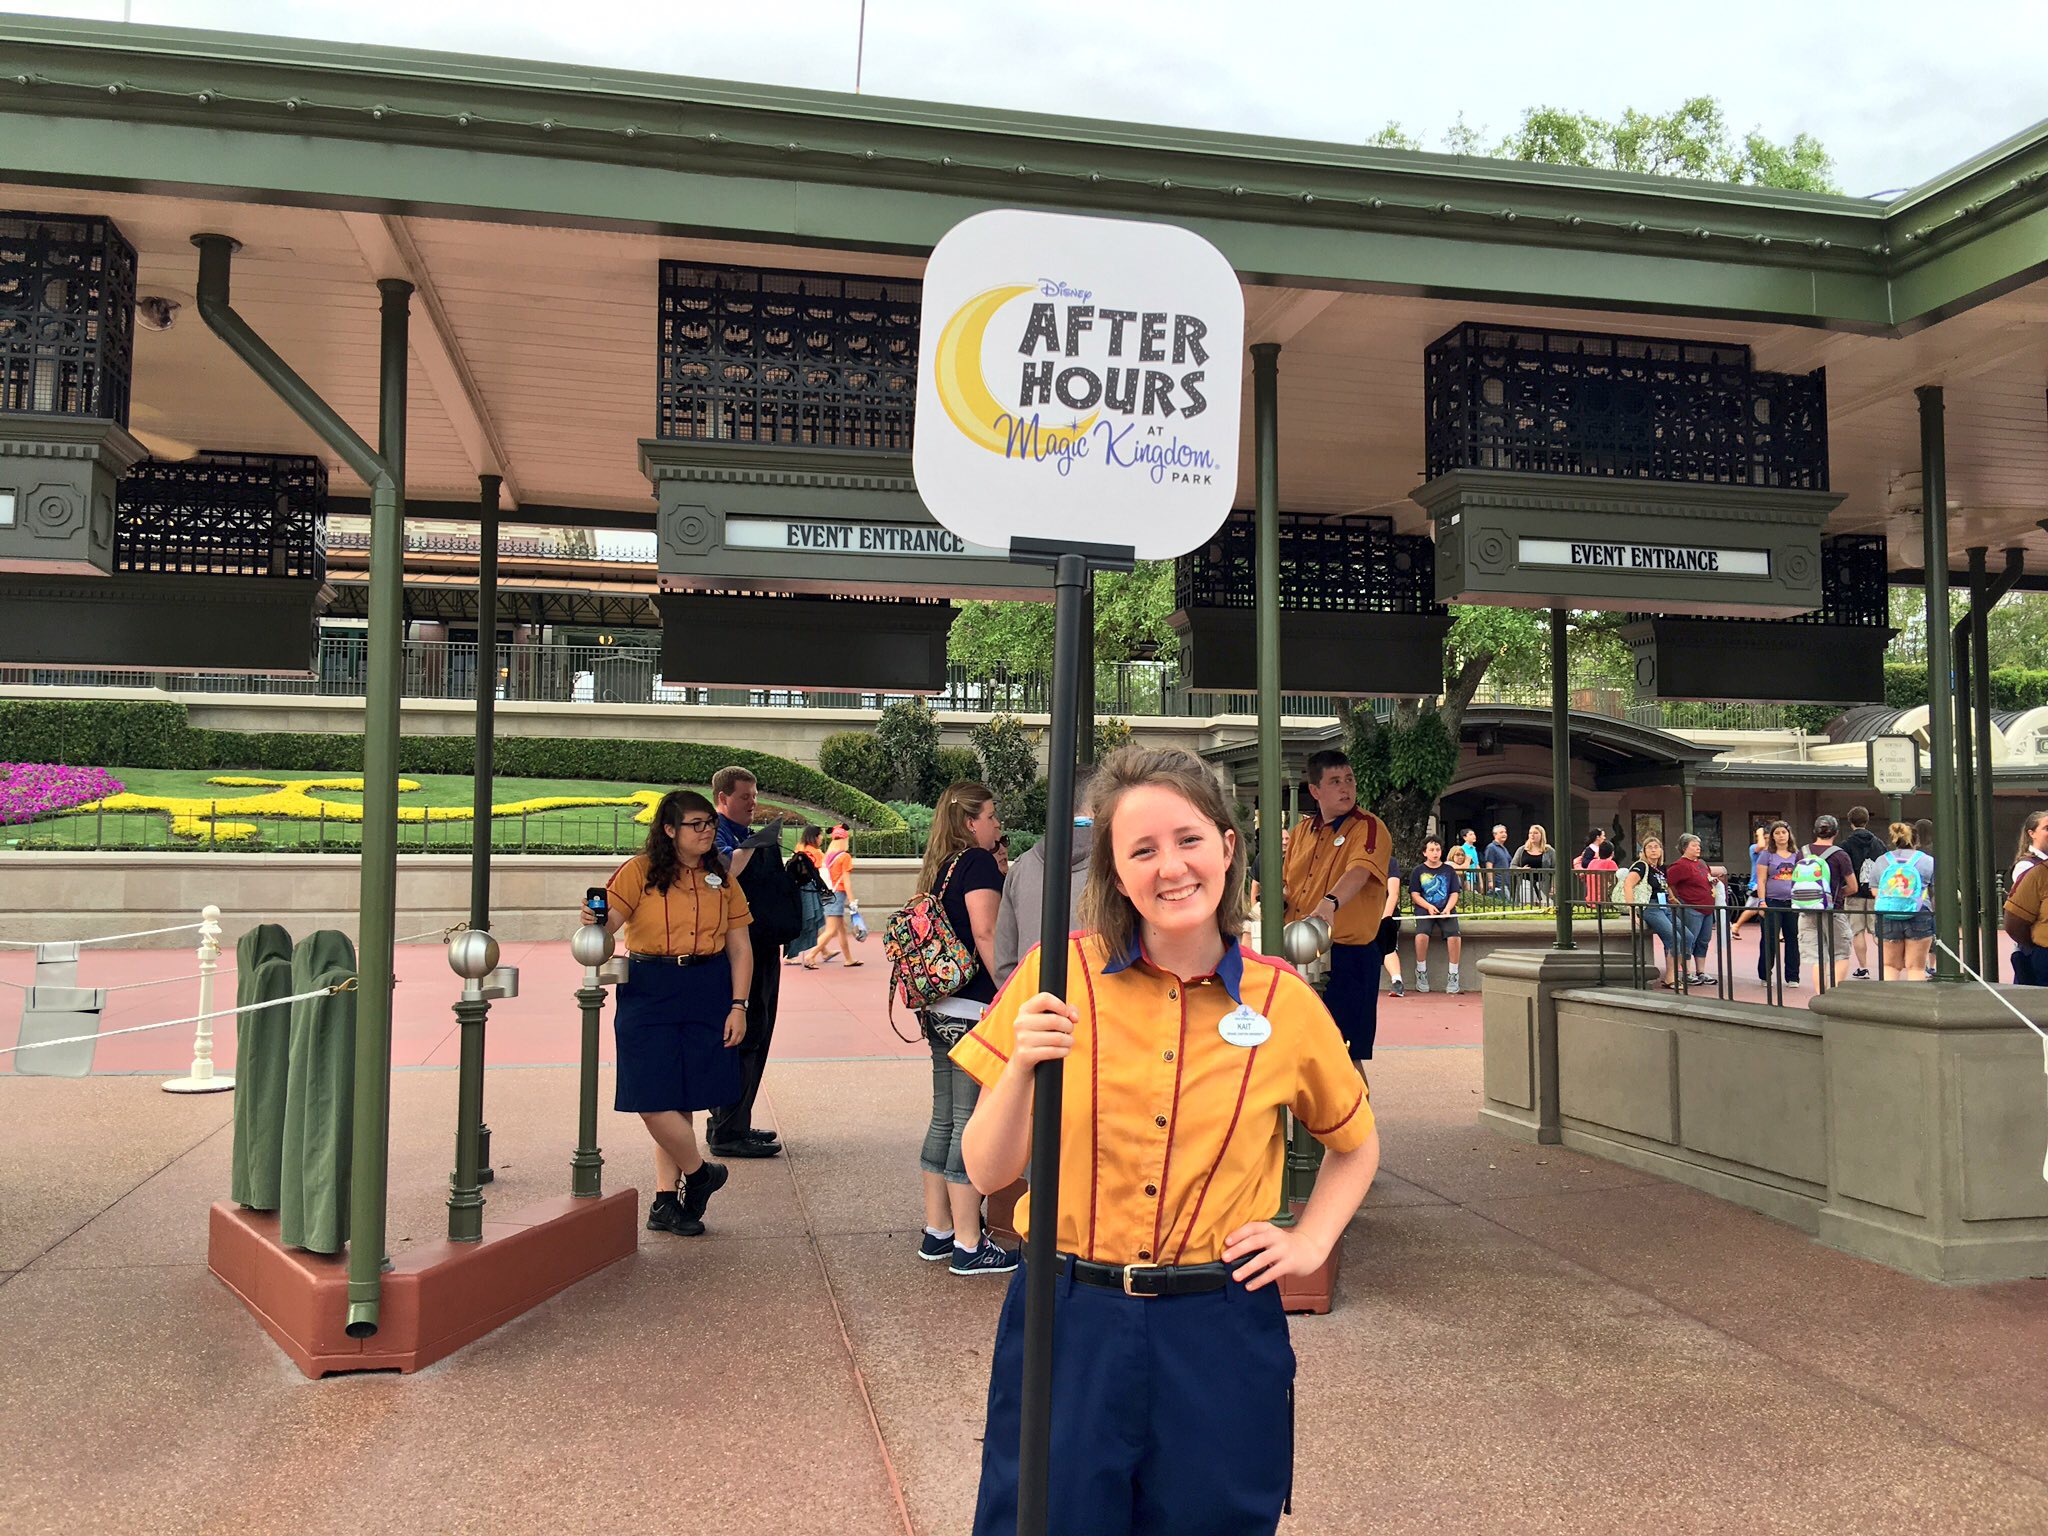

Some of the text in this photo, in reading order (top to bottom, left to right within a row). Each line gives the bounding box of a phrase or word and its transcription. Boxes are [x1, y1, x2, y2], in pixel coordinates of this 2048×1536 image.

[1018, 303, 1210, 367] AFTER
[1019, 361, 1208, 419] HOURS
[993, 413, 1089, 476] Magic
[1147, 426, 1164, 437] AT
[1172, 473, 1212, 485] PARK
[787, 524, 965, 553] EVENT ENTRANCE
[1571, 544, 1719, 571] EVENT ENTRANCE
